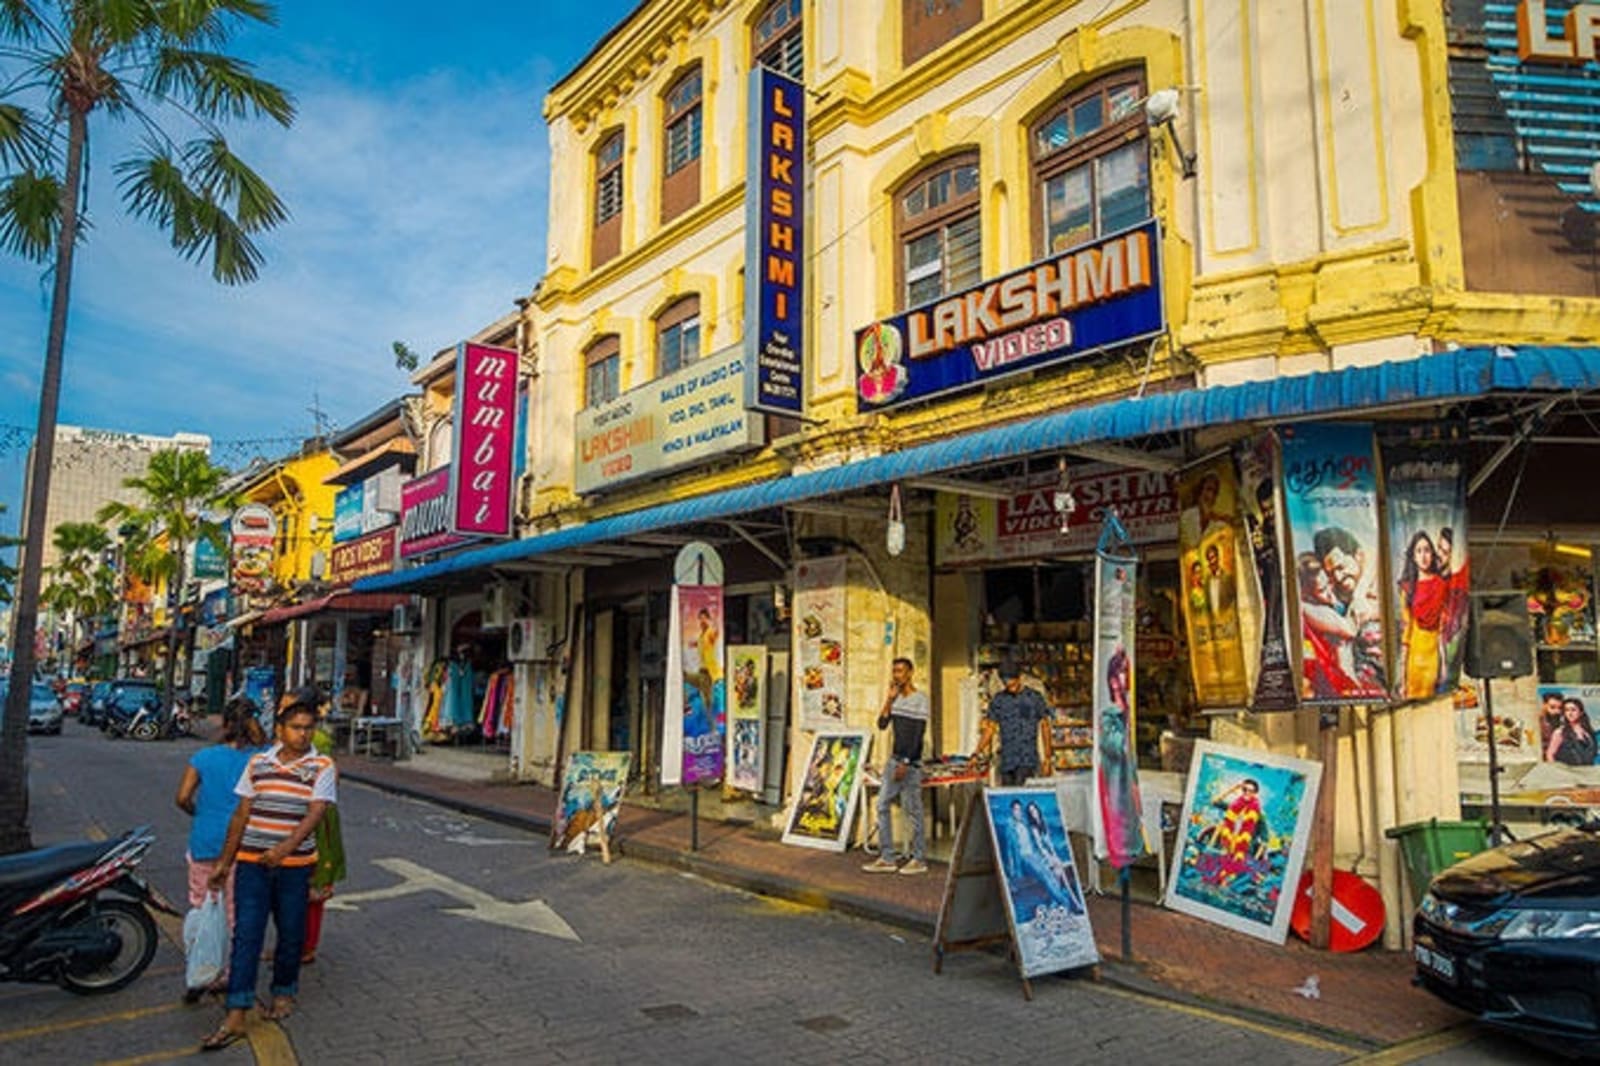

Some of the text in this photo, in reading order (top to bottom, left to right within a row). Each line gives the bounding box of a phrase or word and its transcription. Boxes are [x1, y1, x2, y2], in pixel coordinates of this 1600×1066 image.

[768, 87, 796, 321] LAKSHMI
[908, 231, 1151, 360] LAKSHMI
[972, 318, 1074, 371] VIDEO
[700, 366, 727, 386] AUDIO
[471, 355, 507, 524] mumbai
[581, 414, 654, 463] LAKSHMI
[1007, 472, 1169, 516] LASHM
[1089, 496, 1174, 522] CNTR
